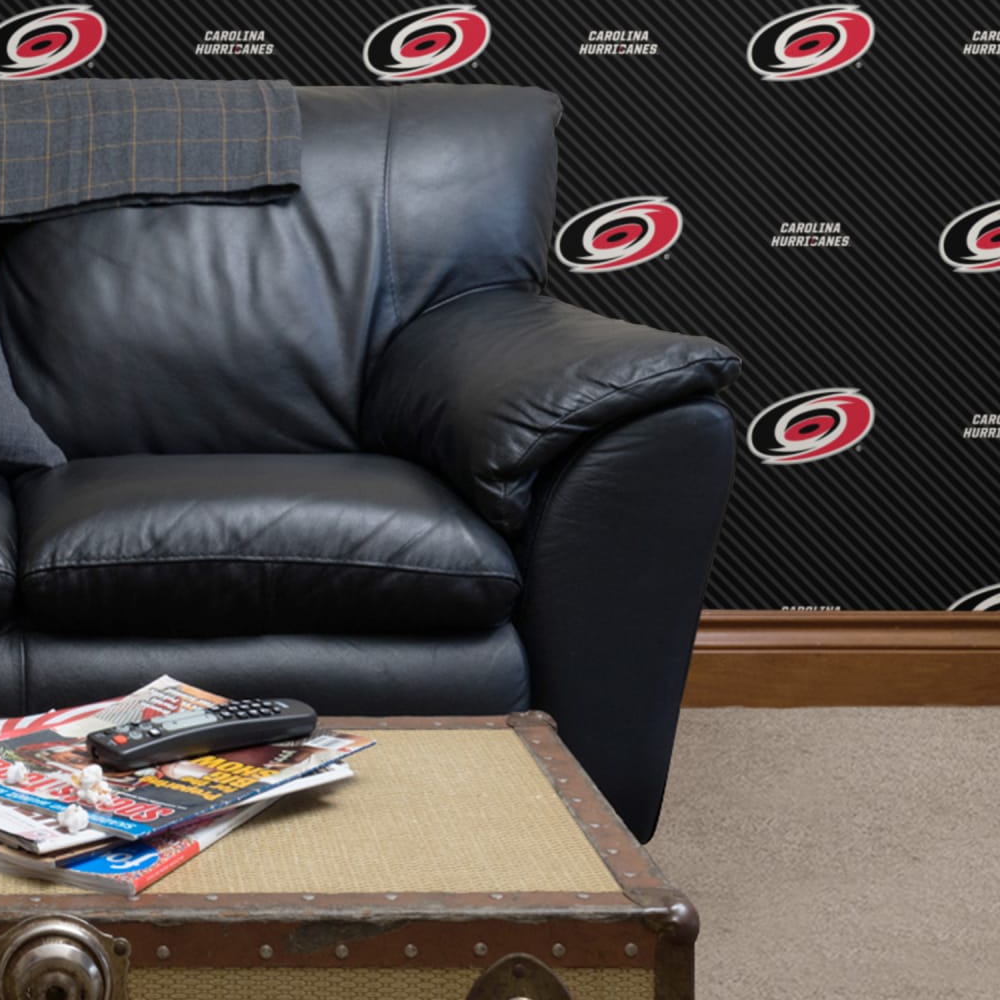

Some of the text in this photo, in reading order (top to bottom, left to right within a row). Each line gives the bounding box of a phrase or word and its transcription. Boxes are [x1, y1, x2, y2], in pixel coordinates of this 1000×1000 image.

[204, 30, 265, 42] CAROLINA
[587, 30, 648, 42] CAROLINA
[195, 43, 275, 56] HURRICANES
[578, 43, 658, 56] HURRICANES
[962, 43, 1000, 56] HURRI
[779, 221, 840, 233] CAROLINA
[770, 234, 850, 247] HURRICANES
[962, 426, 1000, 439] HURRI
[189, 755, 280, 778] SHOW
[203, 771, 259, 789] BIG
